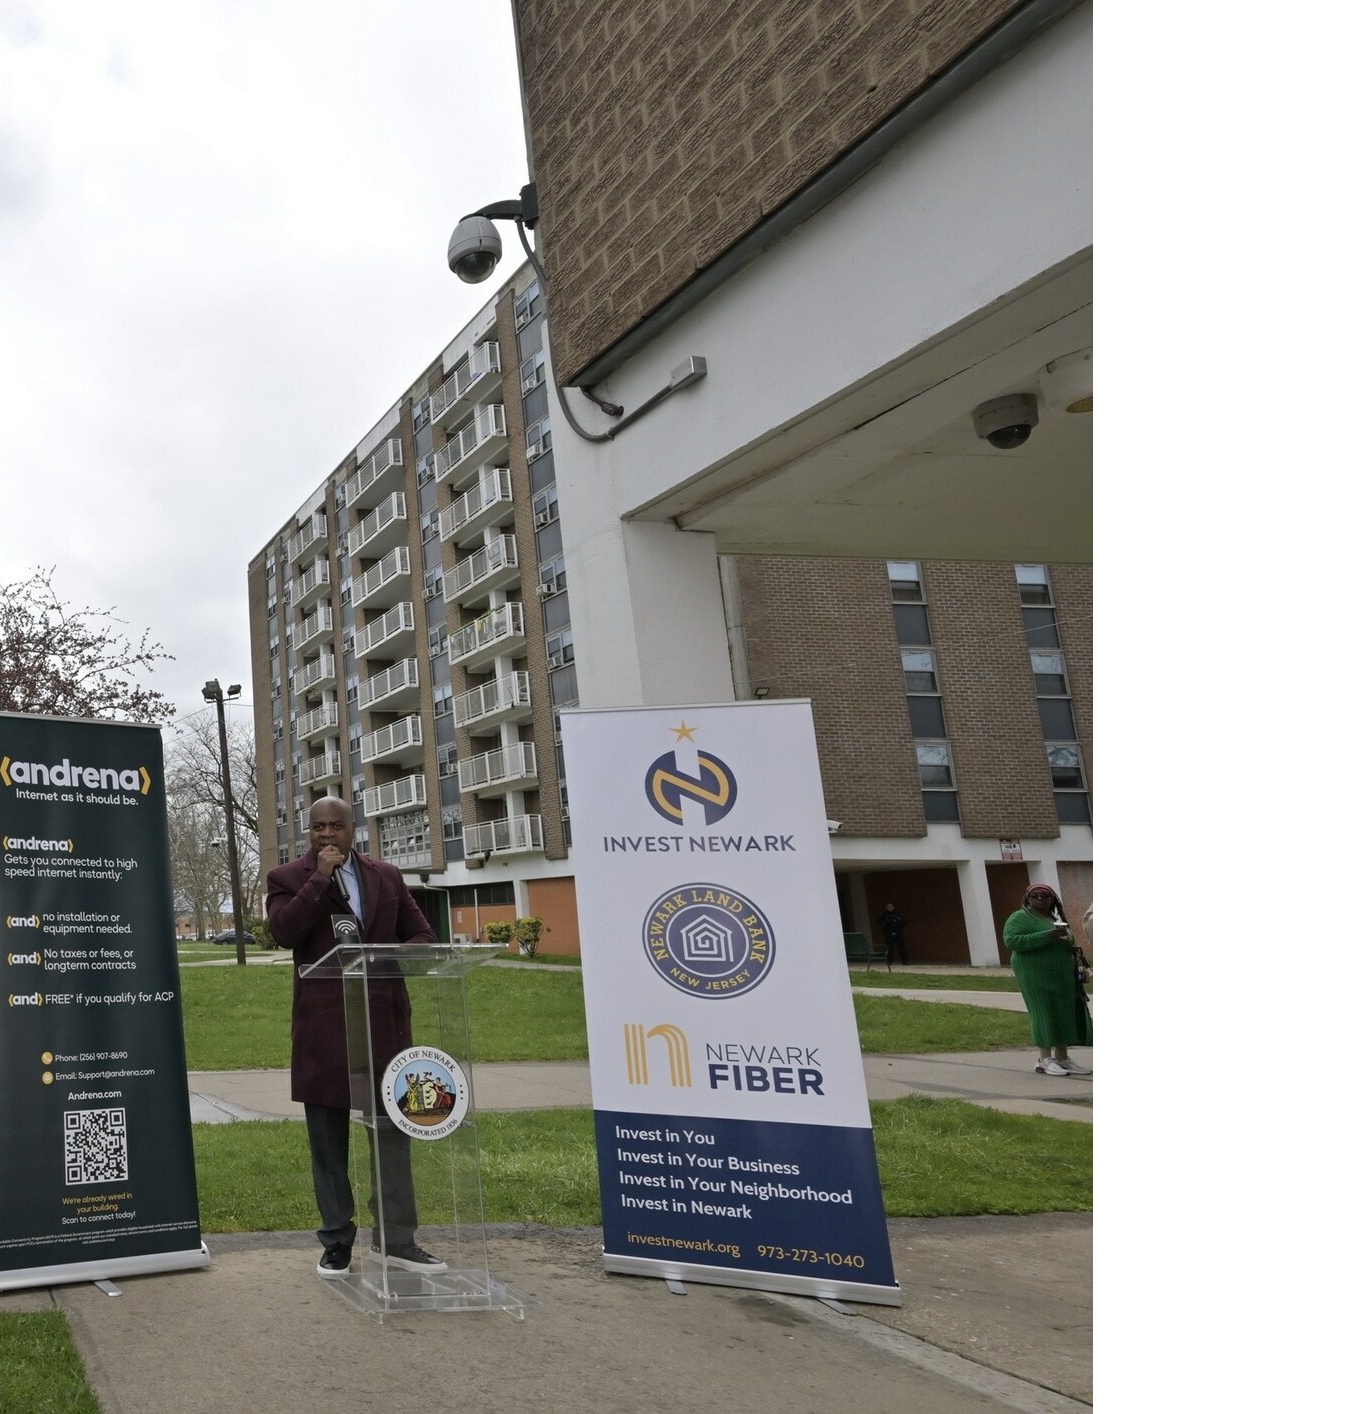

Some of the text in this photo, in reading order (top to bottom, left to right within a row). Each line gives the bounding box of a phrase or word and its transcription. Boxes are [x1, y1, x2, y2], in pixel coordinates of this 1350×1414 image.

[16, 788, 139, 805] Internet as it should be.
[603, 835, 797, 853] INVEST NEWARK
[4, 854, 138, 871] Gets you connected to high
[5, 867, 35, 879] speed
[38, 868, 77, 878] internet
[43, 913, 55, 921] no
[57, 912, 109, 922] installation
[111, 914, 120, 922] or
[43, 924, 133, 936] equipment needed.
[651, 891, 766, 964] NEWARK LAND BANK
[44, 949, 58, 959] No
[61, 950, 88, 959] taxes
[89, 950, 98, 958] or
[100, 948, 123, 960] fees,
[124, 950, 134, 958] or
[44, 961, 137, 973] longterm contracts
[671, 968, 751, 990] NEW JERSEY
[76, 994, 83, 1004] if
[85, 996, 102, 1007] you
[104, 992, 137, 1006] qualify
[139, 992, 153, 1002] for
[155, 992, 174, 1002] ACP
[391, 1051, 457, 1073] CITY OF NEWARK
[706, 1043, 821, 1067] NEWARK
[56, 1069, 155, 1081] Email: Support@andrena.com
[708, 1064, 825, 1096] FIBER
[68, 1091, 122, 1101] Andrena.com
[398, 1120, 446, 1136] INCORPORATED
[616, 1125, 715, 1146] Invest in You
[617, 1148, 800, 1176] Invest in Your Business
[619, 1171, 853, 1204] Invest in Your Neighborhood
[82, 1194, 107, 1203] already
[108, 1192, 126, 1200] wired
[77, 1206, 92, 1215] your
[621, 1194, 752, 1220] Invest in Newark
[62, 1217, 79, 1225] Scan
[88, 1214, 115, 1222] connect
[115, 1211, 136, 1220] today!
[628, 1232, 865, 1269] investnewark.org 973-273-1040
